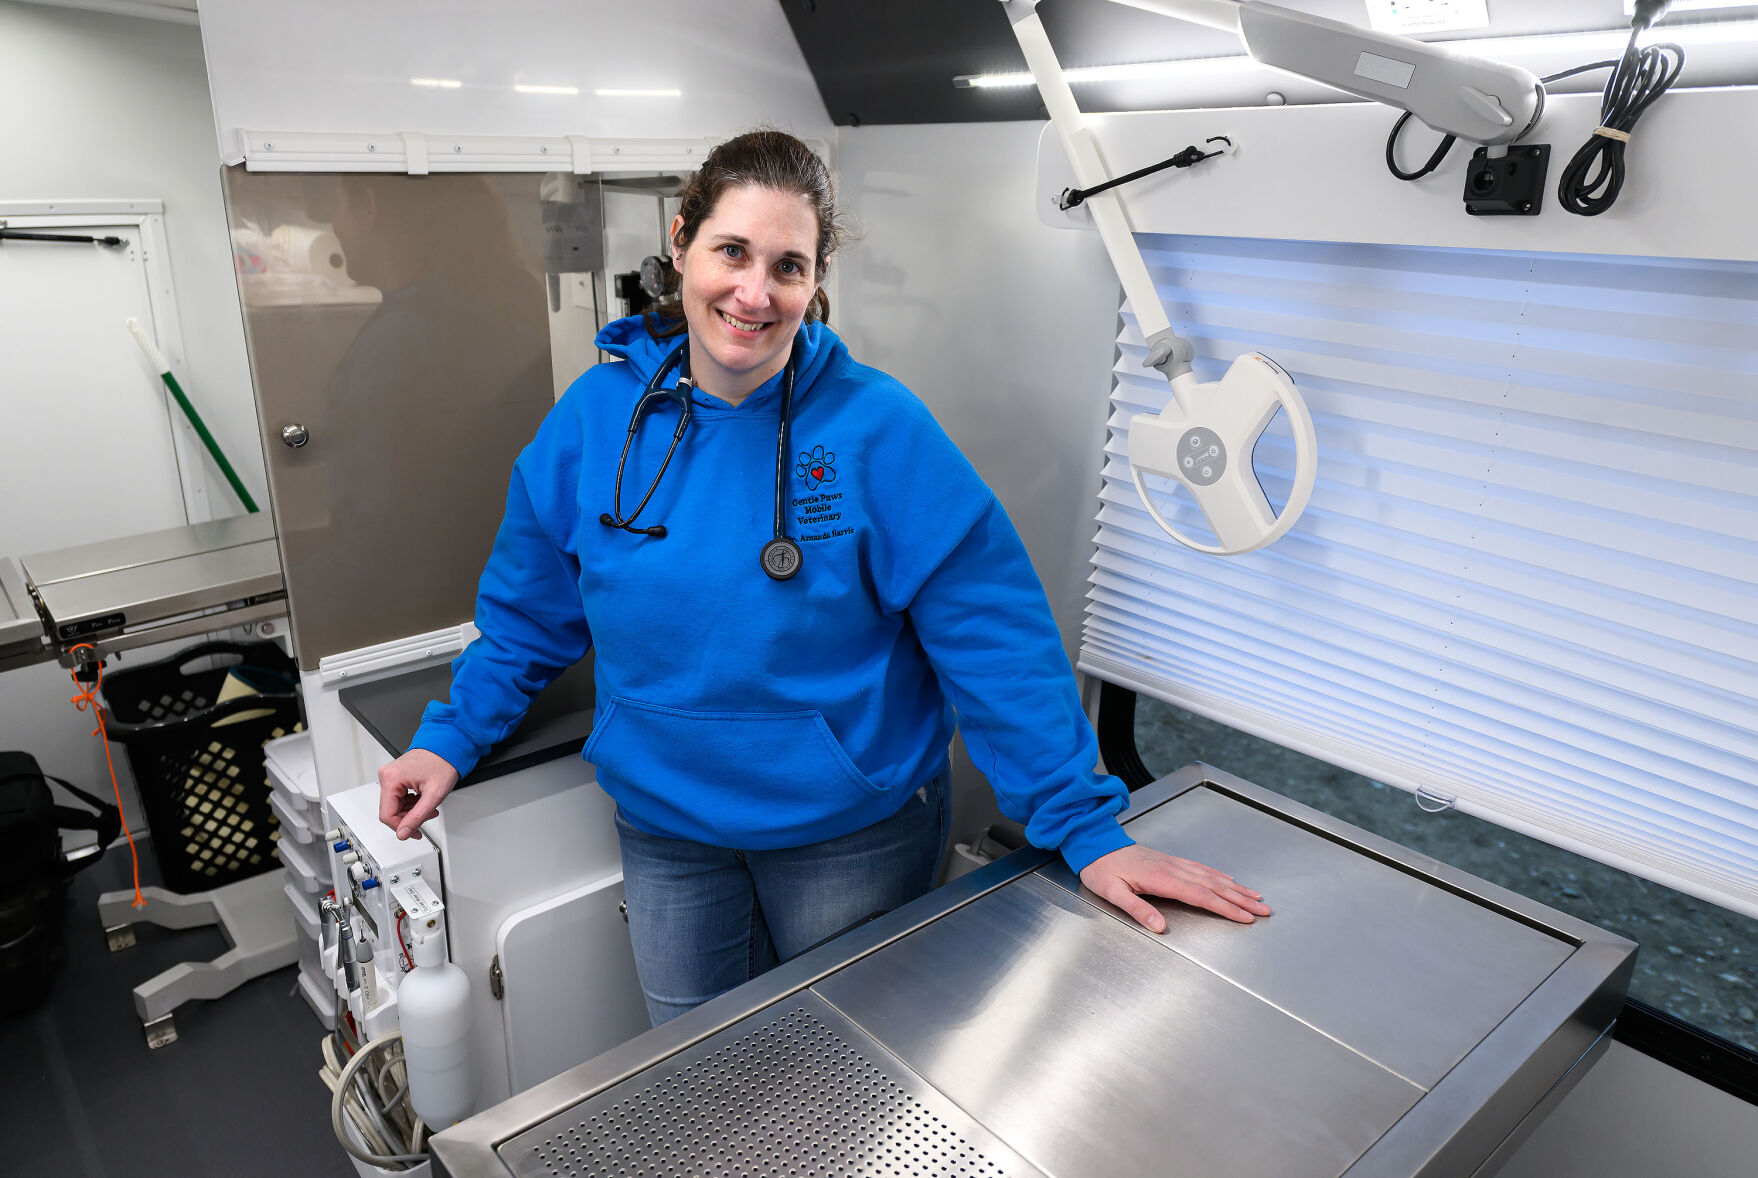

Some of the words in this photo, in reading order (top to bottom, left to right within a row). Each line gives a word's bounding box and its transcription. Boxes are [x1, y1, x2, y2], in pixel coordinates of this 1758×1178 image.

[792, 496, 819, 507] Gentle
[820, 493, 843, 502] Paws
[805, 504, 832, 514] Mobile
[798, 512, 842, 525] Veterinary
[800, 532, 831, 542] Amanda
[832, 526, 855, 537] Harris
